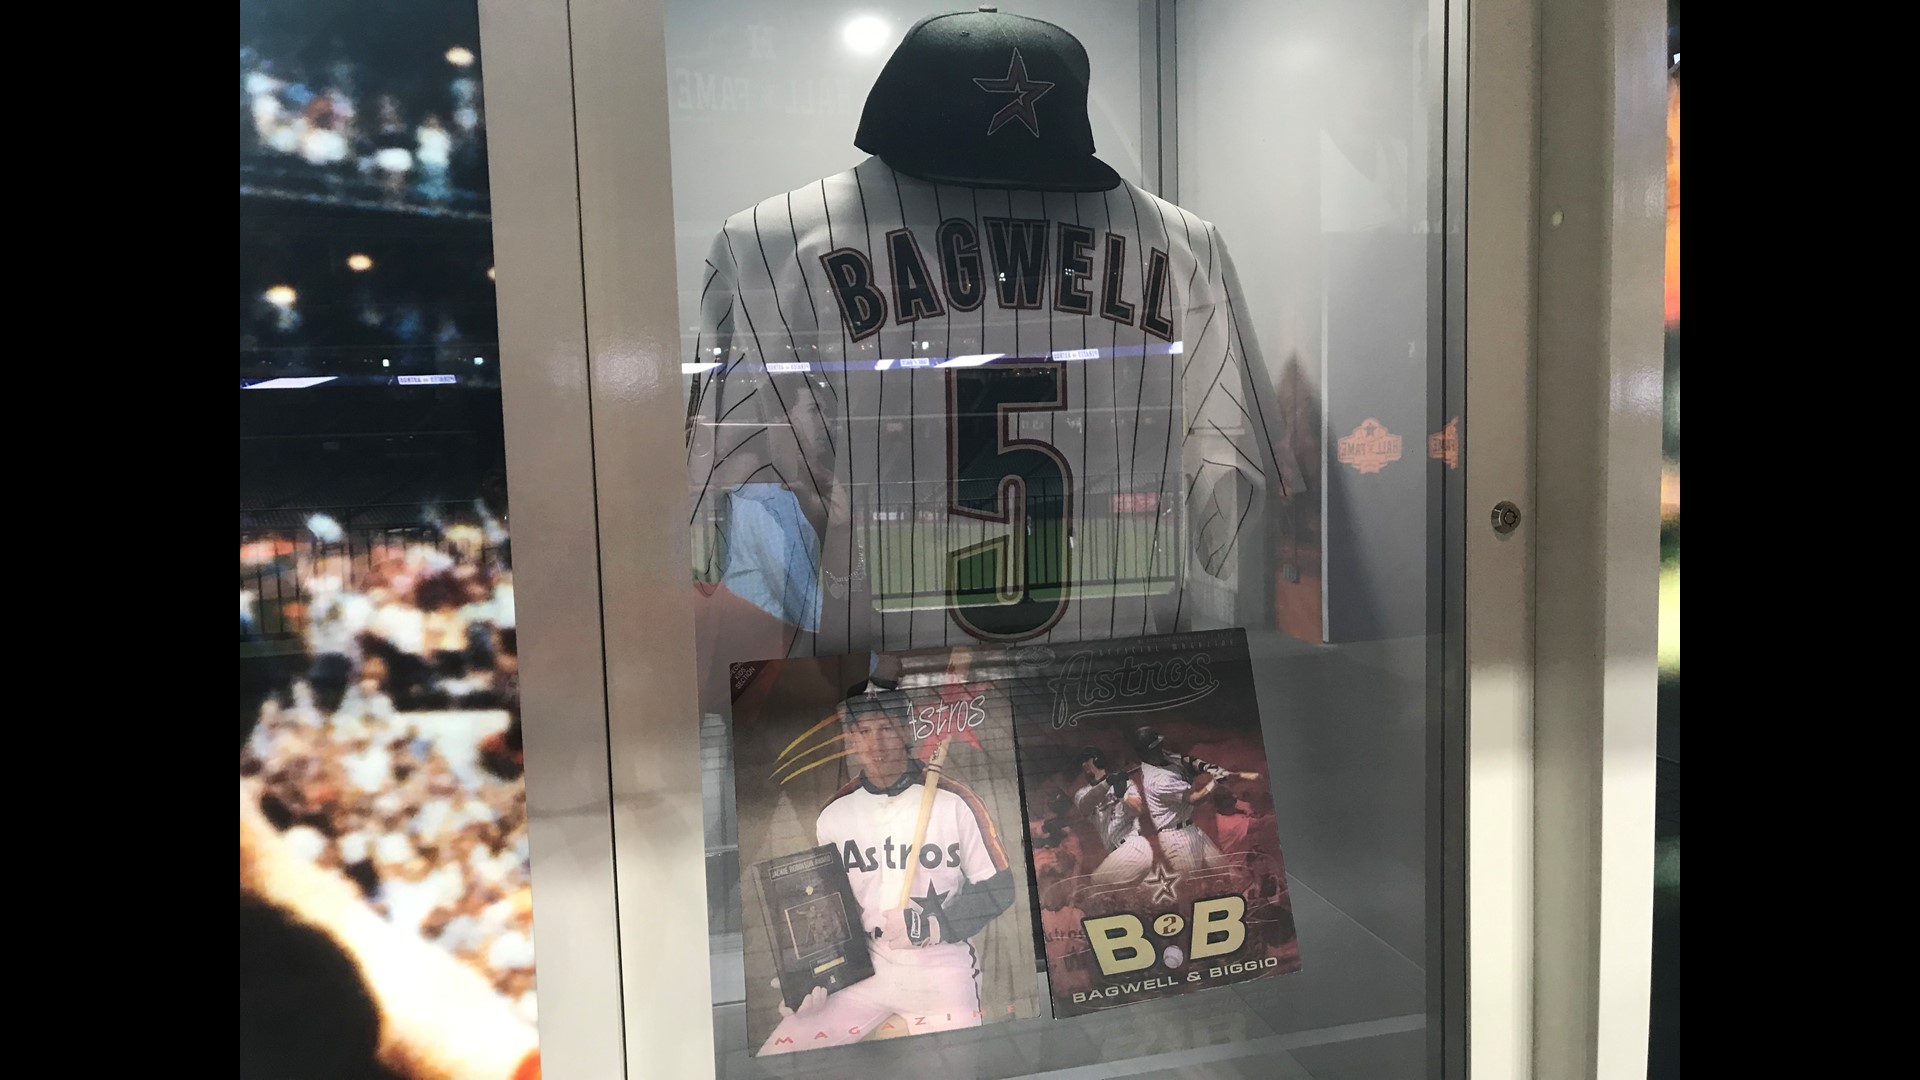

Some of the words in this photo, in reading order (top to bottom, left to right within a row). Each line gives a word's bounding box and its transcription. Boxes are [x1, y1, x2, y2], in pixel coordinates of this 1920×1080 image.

[819, 216, 1174, 343] BAGWELL
[945, 358, 1073, 643] 5
[735, 665, 756, 690] SECTION
[1048, 651, 1220, 730] Astros
[906, 695, 986, 741] Astros
[843, 836, 961, 873] Astros
[1072, 974, 1179, 1004] BAGWELL
[1186, 971, 1202, 983] &
[1209, 956, 1279, 979] BIGGIO
[774, 1004, 1016, 1046] MAGAZINE
